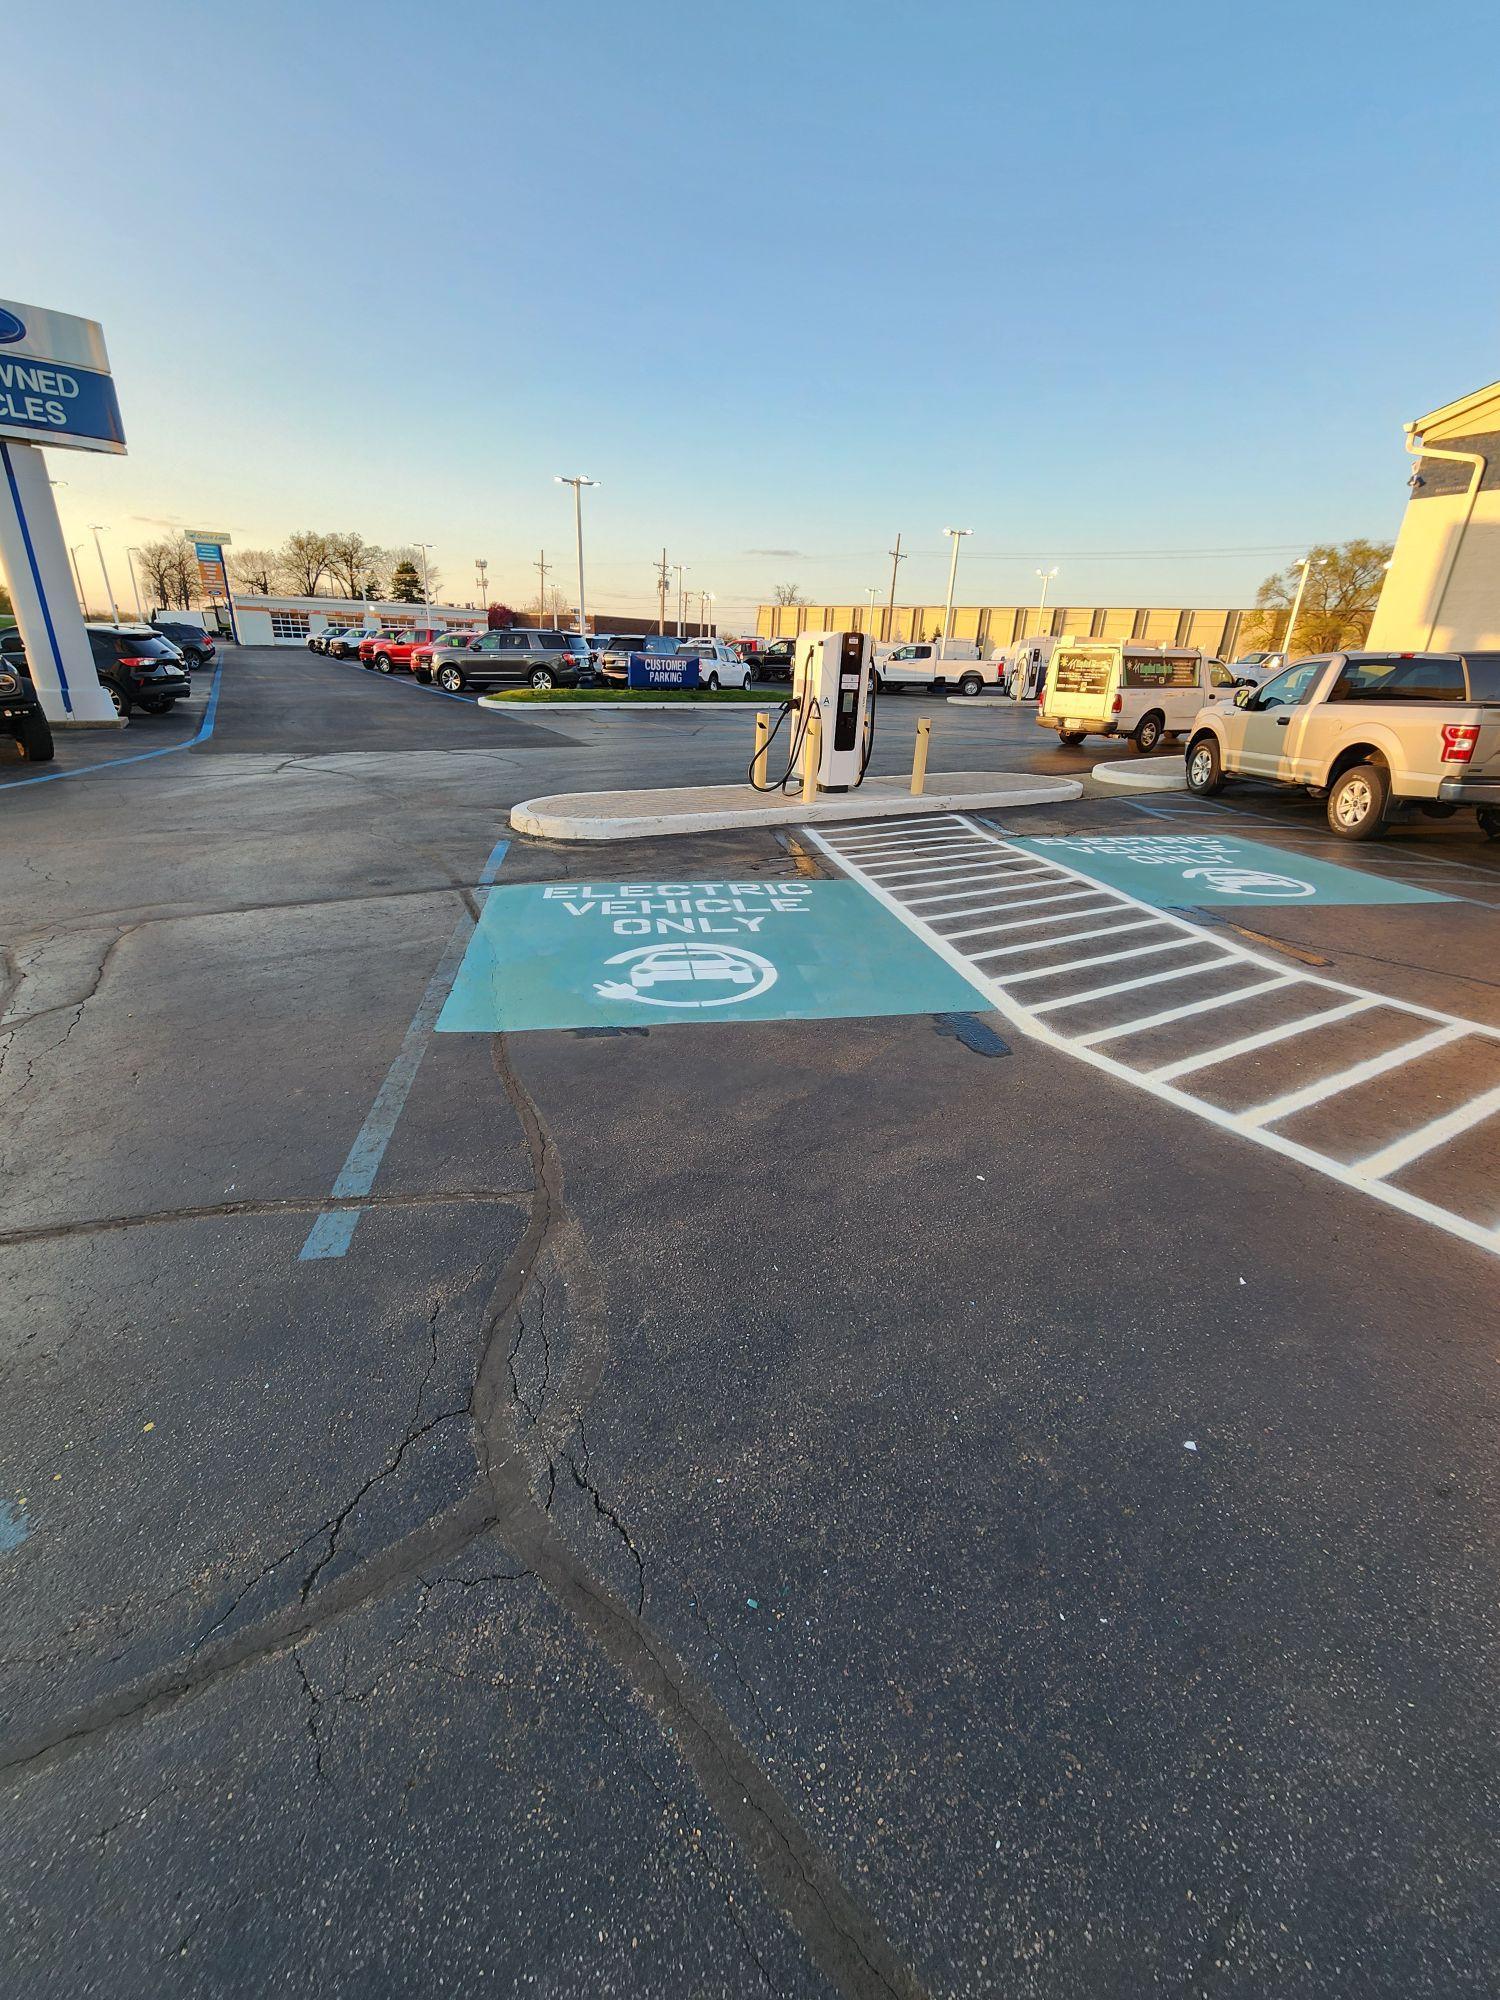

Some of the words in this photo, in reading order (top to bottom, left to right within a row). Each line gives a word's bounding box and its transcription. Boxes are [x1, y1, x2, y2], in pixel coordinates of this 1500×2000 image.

[644, 658, 687, 671] CUSTOMER
[649, 672, 683, 683] PARKING
[823, 696, 830, 704] A
[1031, 837, 1220, 846] ELECTRIC
[1067, 845, 1240, 854] VEHICLE
[1127, 855, 1233, 864] ONLY
[542, 883, 813, 899] ELECTRIC
[562, 898, 810, 916] VEHICLE
[613, 916, 765, 935] ONLY
